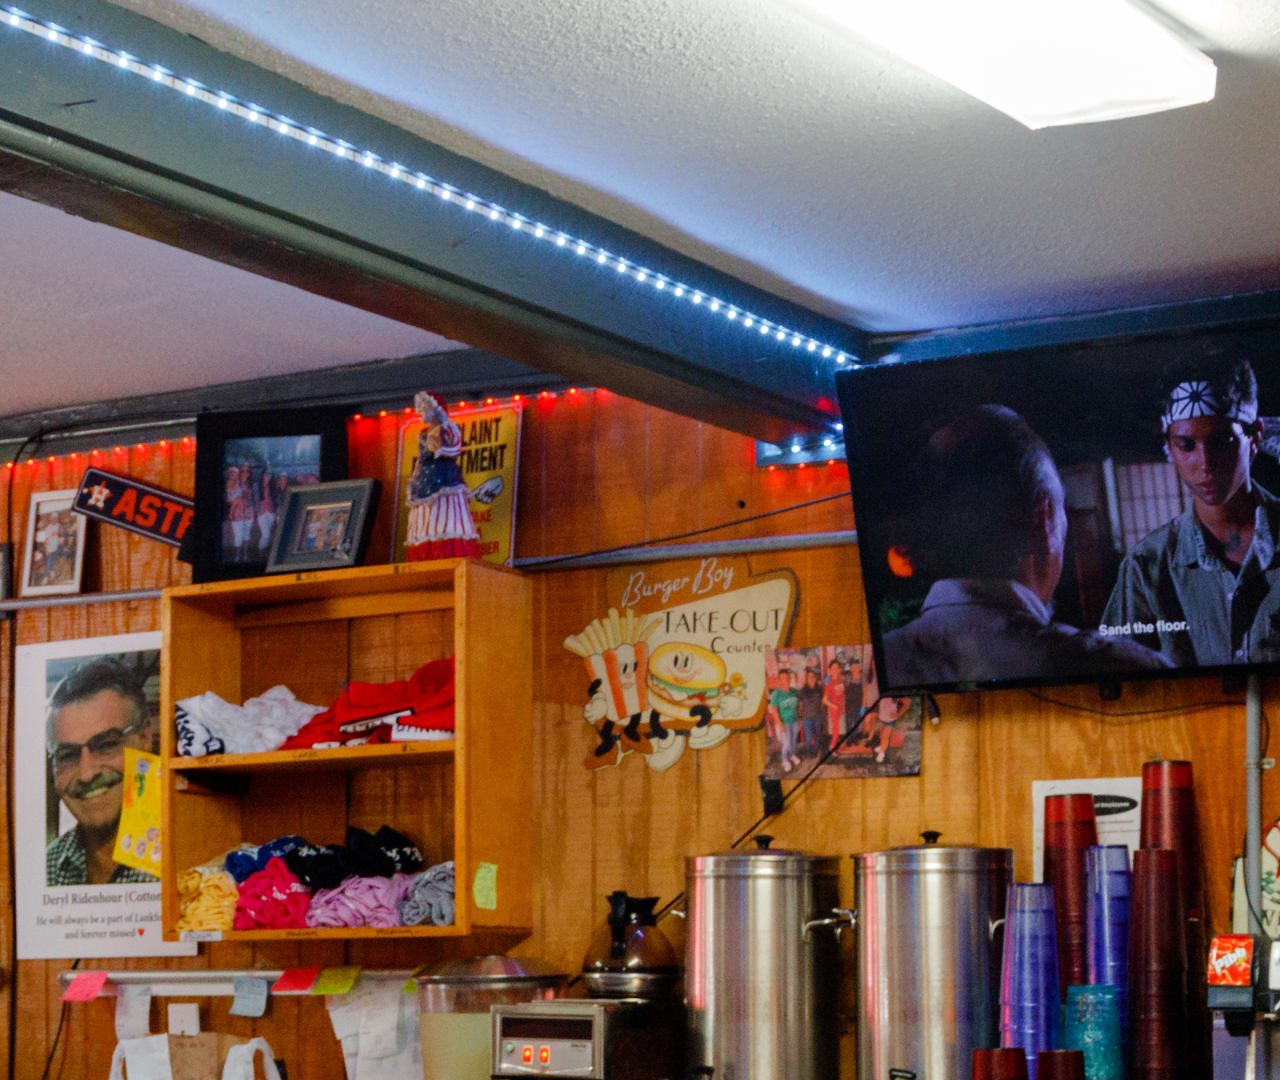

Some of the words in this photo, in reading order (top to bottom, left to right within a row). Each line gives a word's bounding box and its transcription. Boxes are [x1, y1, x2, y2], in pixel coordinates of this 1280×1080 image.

[111, 487, 195, 537] ASTR
[622, 571, 691, 608] Burger
[692, 557, 735, 595] Boy
[662, 607, 784, 634] TAKE-OUT
[1098, 621, 1131, 637] Sand
[1132, 620, 1155, 634] the
[1156, 619, 1191, 633] floor.
[42, 893, 69, 910] Deryl
[71, 891, 122, 905] Ridenhour
